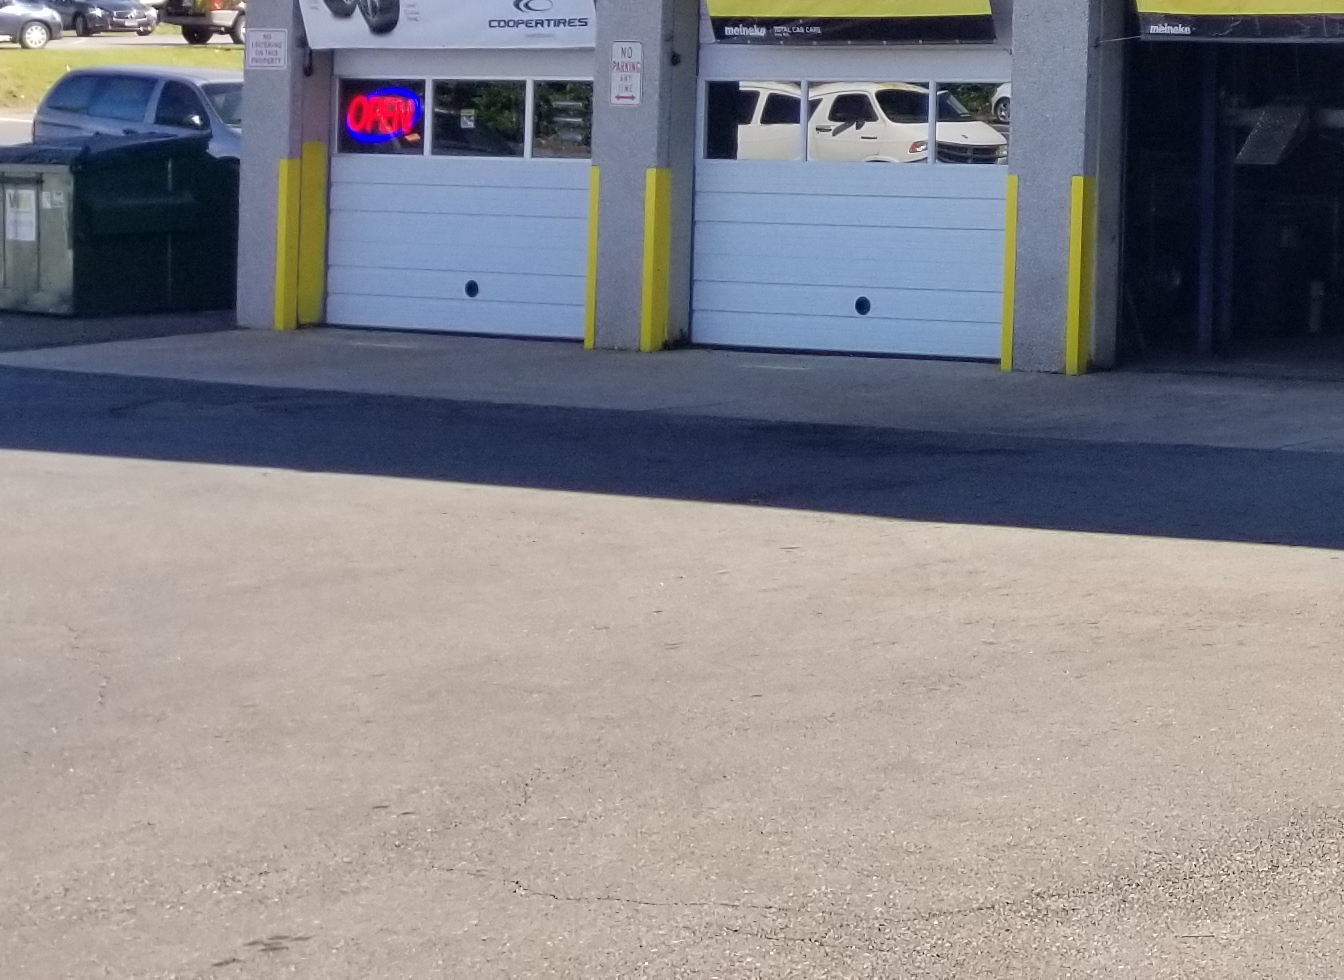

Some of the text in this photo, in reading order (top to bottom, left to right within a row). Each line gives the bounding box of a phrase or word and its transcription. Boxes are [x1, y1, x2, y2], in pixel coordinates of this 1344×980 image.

[621, 46, 633, 59] NO
[612, 60, 641, 73] PARKING
[347, 95, 415, 134] OPEN
